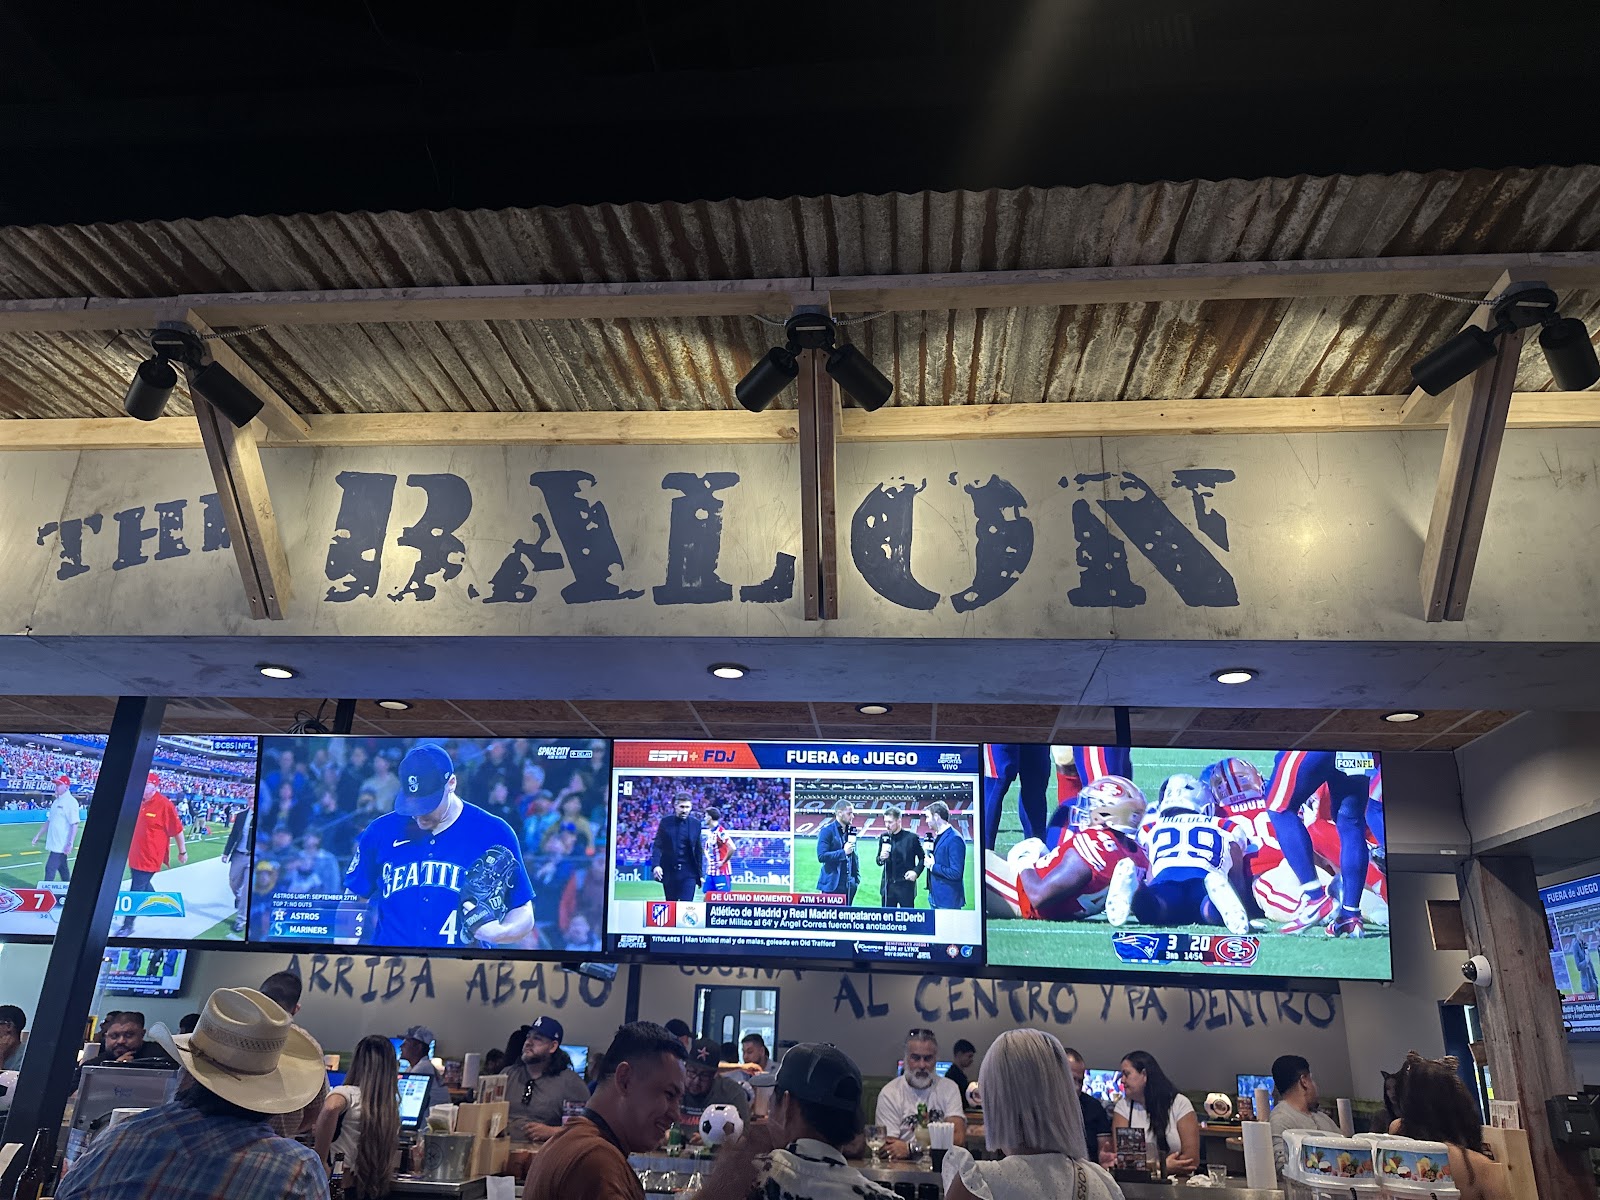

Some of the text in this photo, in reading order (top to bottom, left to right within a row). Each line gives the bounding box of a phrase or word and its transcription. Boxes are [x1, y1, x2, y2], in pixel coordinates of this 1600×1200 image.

[319, 468, 1240, 613] BALON
[703, 749, 736, 763] FDJ
[786, 749, 919, 766] FUERA de JUEGO
[1337, 759, 1373, 768] FOX NFL
[7, 779, 21, 789] SEE
[22, 780, 36, 790] THE
[1152, 826, 1223, 869] 29
[382, 860, 463, 899] SEATTL
[33, 893, 45, 910] 7
[273, 892, 294, 900] ASTROS
[710, 892, 793, 903] DE ÚLTIMO MOMENTO
[800, 895, 843, 905] ATM 1-1 MAD
[1546, 882, 1599, 904] FUERA de JUEGO
[290, 911, 320, 921] ASTROS
[355, 912, 363, 923] 4
[741, 906, 752, 918] de
[753, 907, 782, 918] Madrid
[782, 909, 788, 920] y
[789, 908, 808, 919] Real
[809, 908, 838, 920] Madrid
[838, 911, 882, 923] empataron
[882, 913, 894, 922] en
[289, 925, 328, 935] MARINERS
[354, 926, 363, 937] 3
[439, 909, 459, 945] 4
[728, 917, 753, 927] Militao
[754, 918, 761, 927] al
[801, 920, 827, 930] Correa
[828, 920, 852, 930] fueron
[853, 921, 865, 930] los
[865, 922, 907, 932] anotadores
[651, 935, 681, 943] TITULARES
[766, 939, 790, 947] goleado
[1167, 934, 1212, 952] 3 20
[465, 961, 615, 1009] ABAJO
[833, 971, 889, 1020] AL
[914, 975, 1079, 1025] CENTRO
[1100, 984, 1114, 1023] Y
[1184, 987, 1337, 1031] DENTRO
